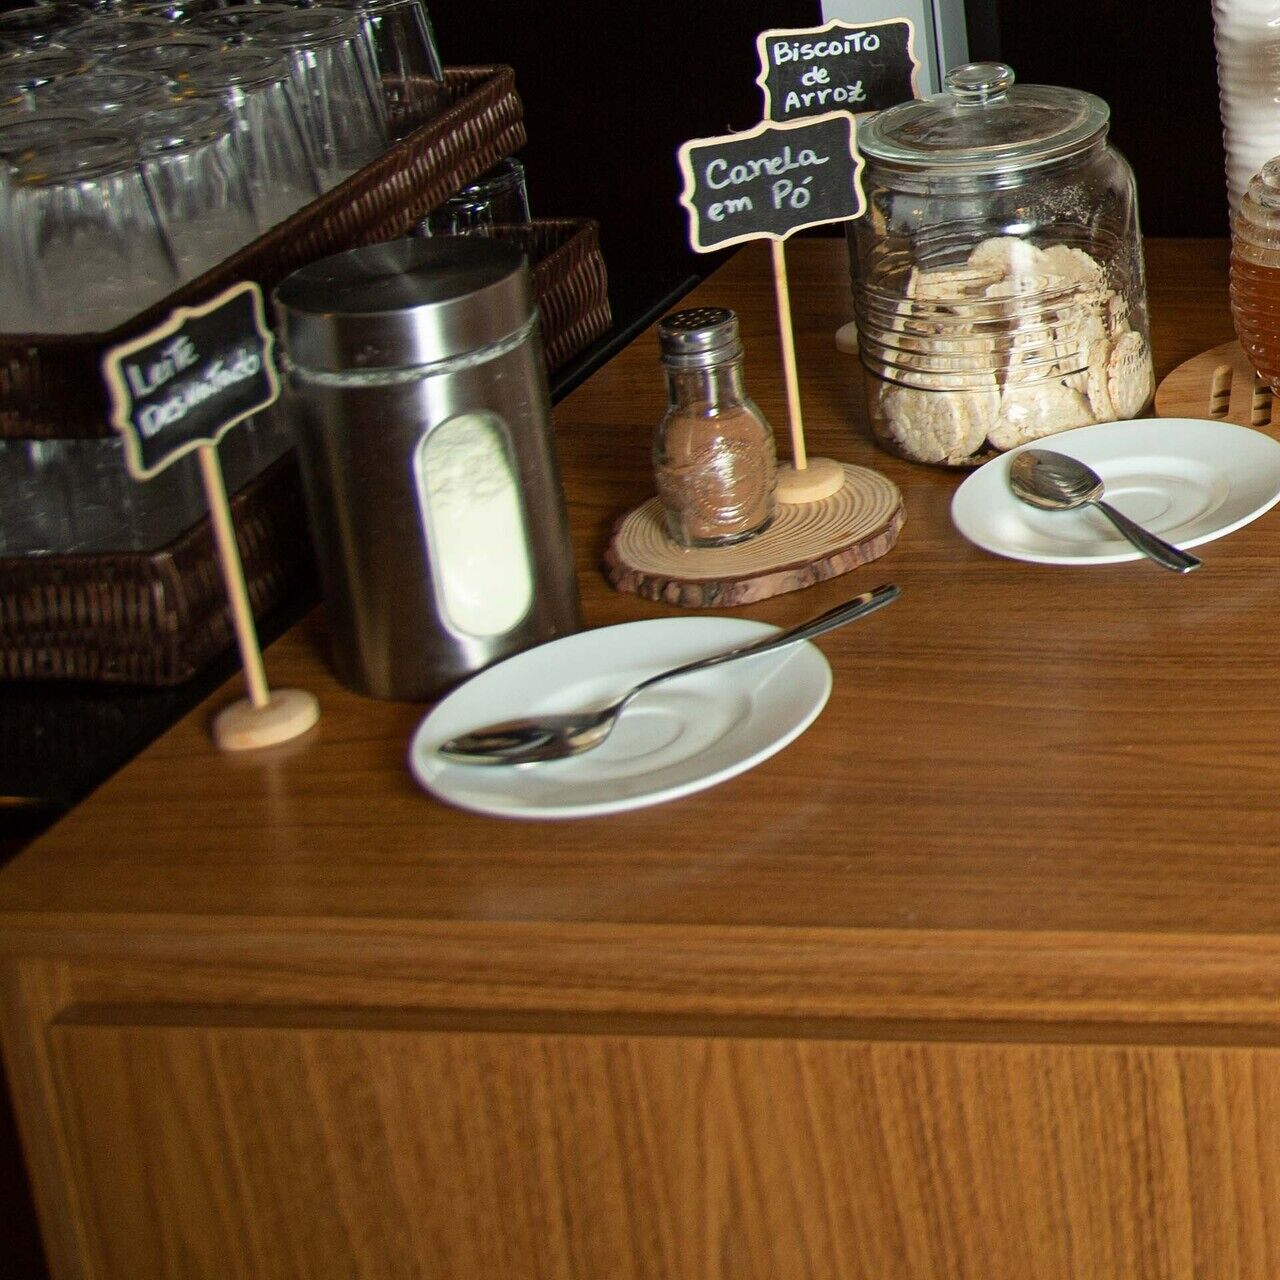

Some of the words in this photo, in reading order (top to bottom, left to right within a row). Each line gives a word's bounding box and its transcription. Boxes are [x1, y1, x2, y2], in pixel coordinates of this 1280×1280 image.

[802, 66, 830, 86] de
[785, 80, 866, 113] Arroz
[708, 196, 753, 222] em
[772, 176, 813, 209] Pó
